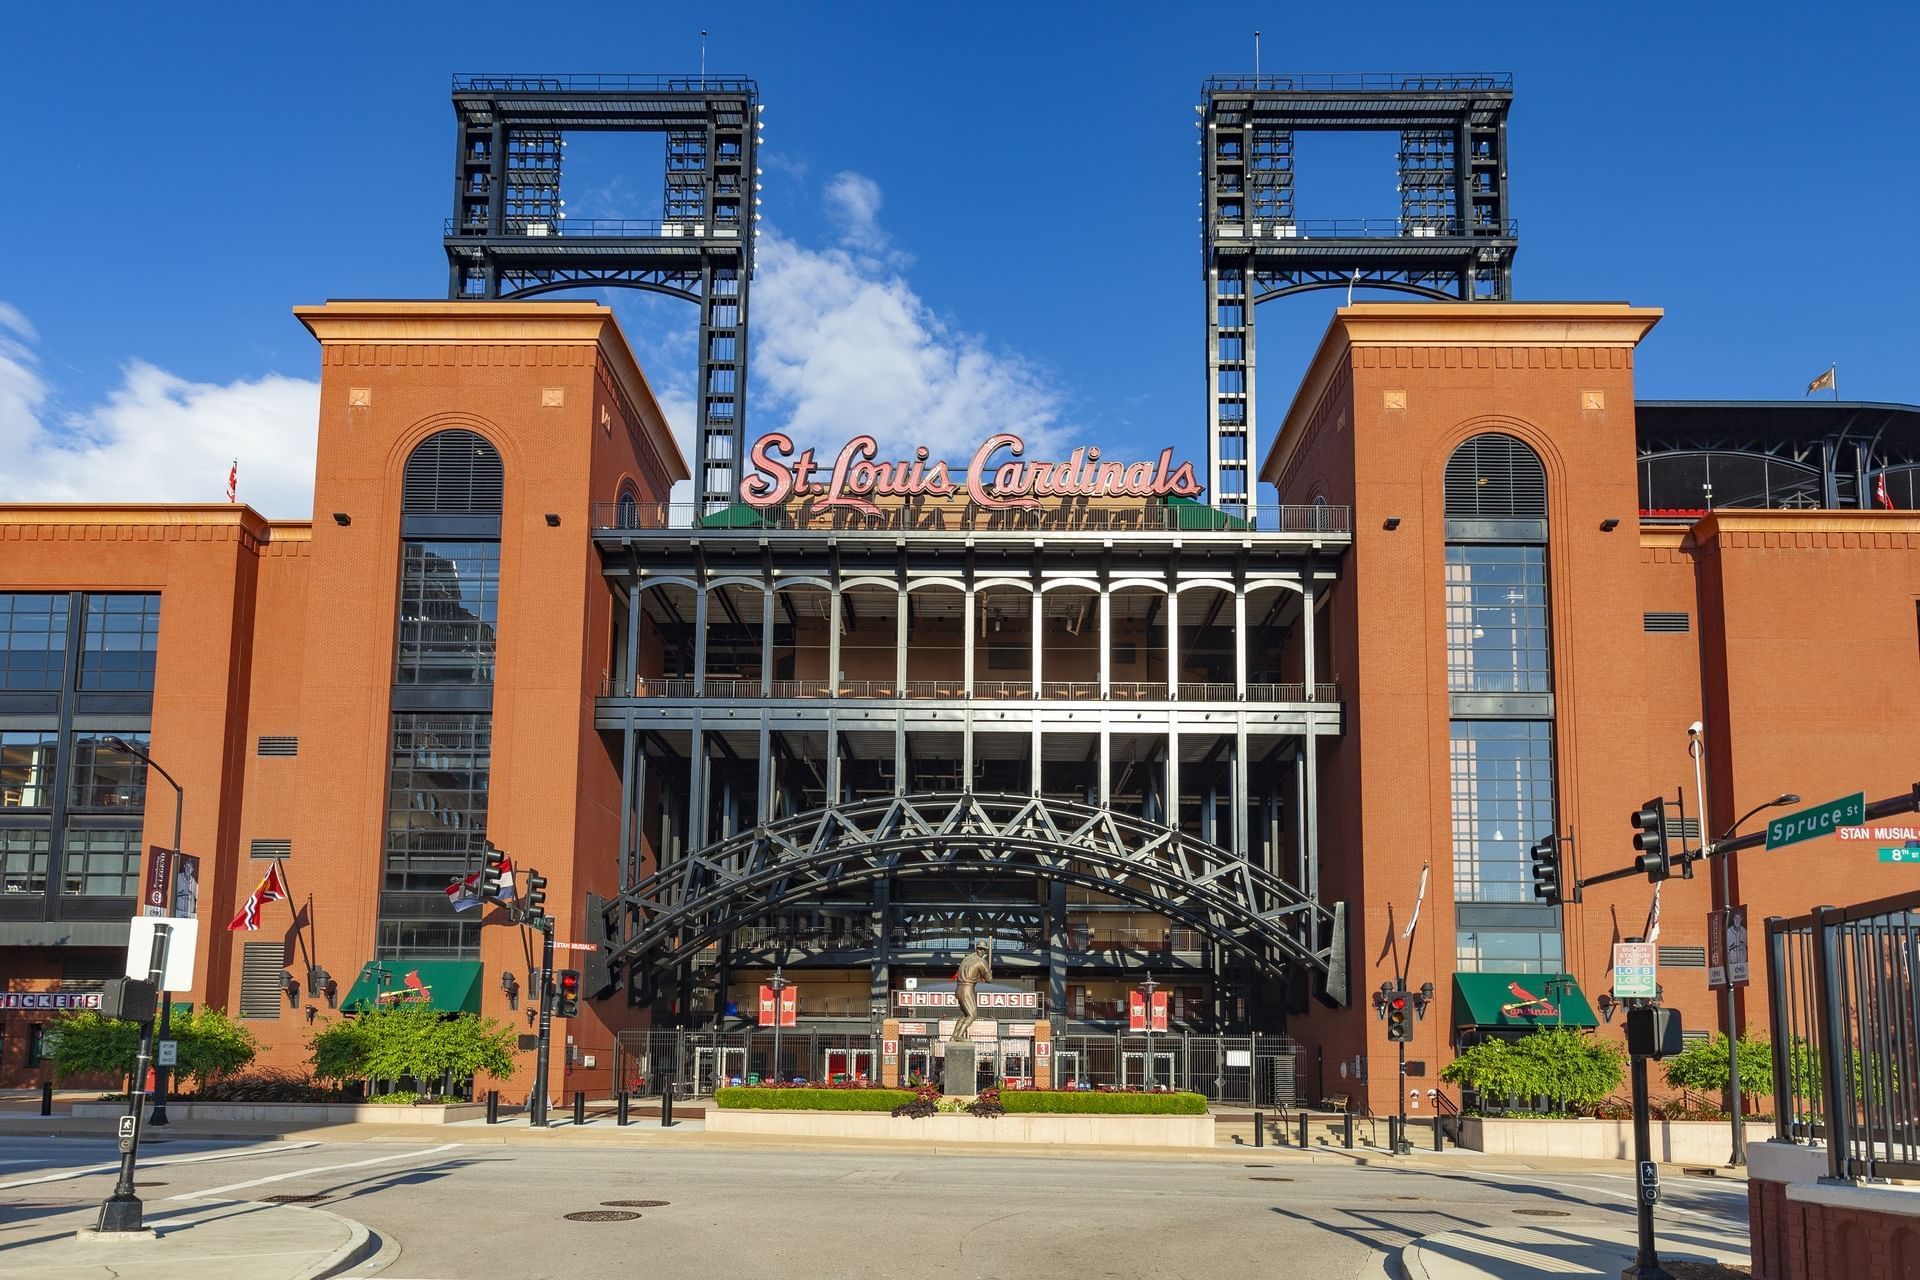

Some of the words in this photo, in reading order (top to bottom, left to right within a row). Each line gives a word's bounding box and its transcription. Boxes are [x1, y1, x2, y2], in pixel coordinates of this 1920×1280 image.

[740, 432, 824, 508] St.
[810, 434, 960, 520] Louis
[967, 433, 1206, 512] Cardinals
[1772, 808, 1842, 841] Spruce
[1846, 804, 1859, 817] St
[1840, 827, 1870, 840] STAN
[1874, 827, 1918, 840] MUSIAL
[1643, 967, 1651, 975] B
[1643, 977, 1651, 985] C
[0, 995, 98, 1007] ICKETS
[902, 993, 959, 1005] THIR
[980, 994, 1033, 1006] BASE
[887, 1042, 894, 1053] 3
[1040, 1044, 1046, 1055] 3
